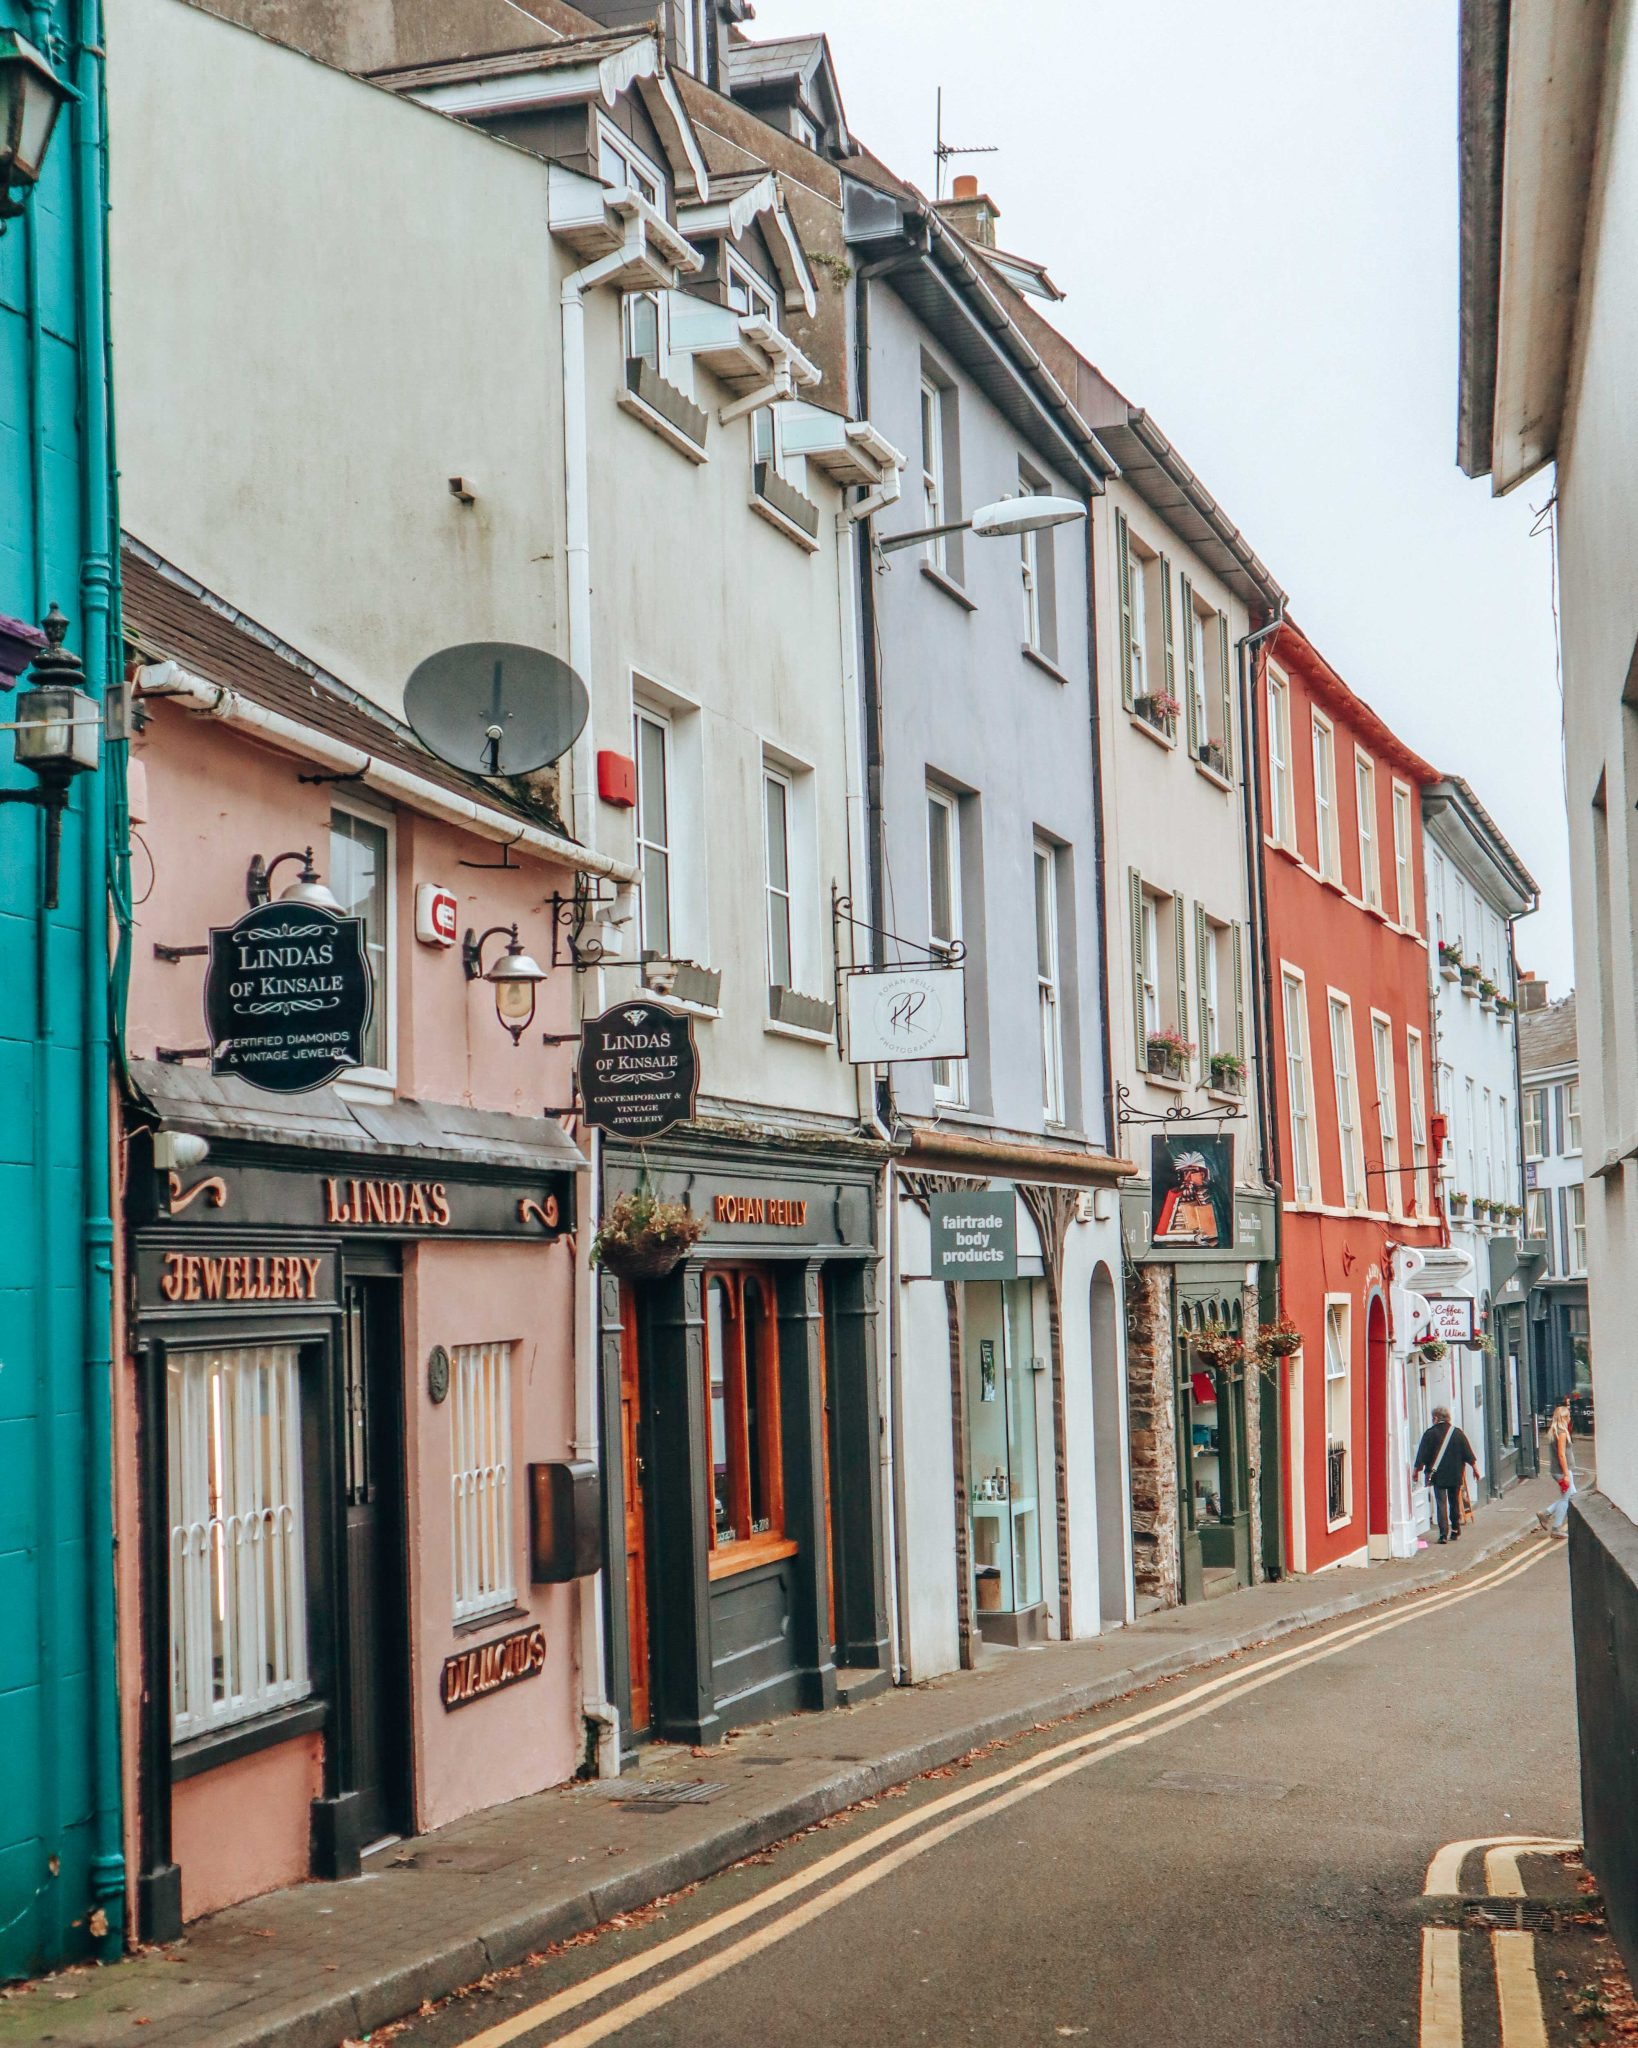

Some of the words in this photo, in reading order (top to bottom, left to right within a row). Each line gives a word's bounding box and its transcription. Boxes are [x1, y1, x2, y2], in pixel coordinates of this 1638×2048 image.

[238, 944, 333, 970] LINDAS
[229, 982, 255, 998] OF
[260, 975, 343, 995] KINSALE
[227, 1035, 283, 1049] CERTIFIED
[287, 1031, 350, 1045] DIAMONDS
[601, 1033, 671, 1051] LINDAS
[230, 1053, 238, 1063] &
[242, 1050, 289, 1062] VINTAGE
[596, 1059, 614, 1071] OF
[618, 1055, 678, 1069] KINSALE
[594, 1092, 672, 1104] CONTEMPORARY
[617, 1104, 658, 1113] VINTAGE
[326, 1177, 451, 1227] LINDA'S
[714, 1194, 765, 1224] ROHAN
[767, 1199, 807, 1226] REILLY
[942, 1214, 1003, 1229] fairtrade
[956, 1232, 990, 1248] body
[942, 1248, 1004, 1265] products
[161, 1252, 321, 1301] JEWELLERY
[1440, 1316, 1460, 1326] Eats
[1444, 1328, 1467, 1338] Wine
